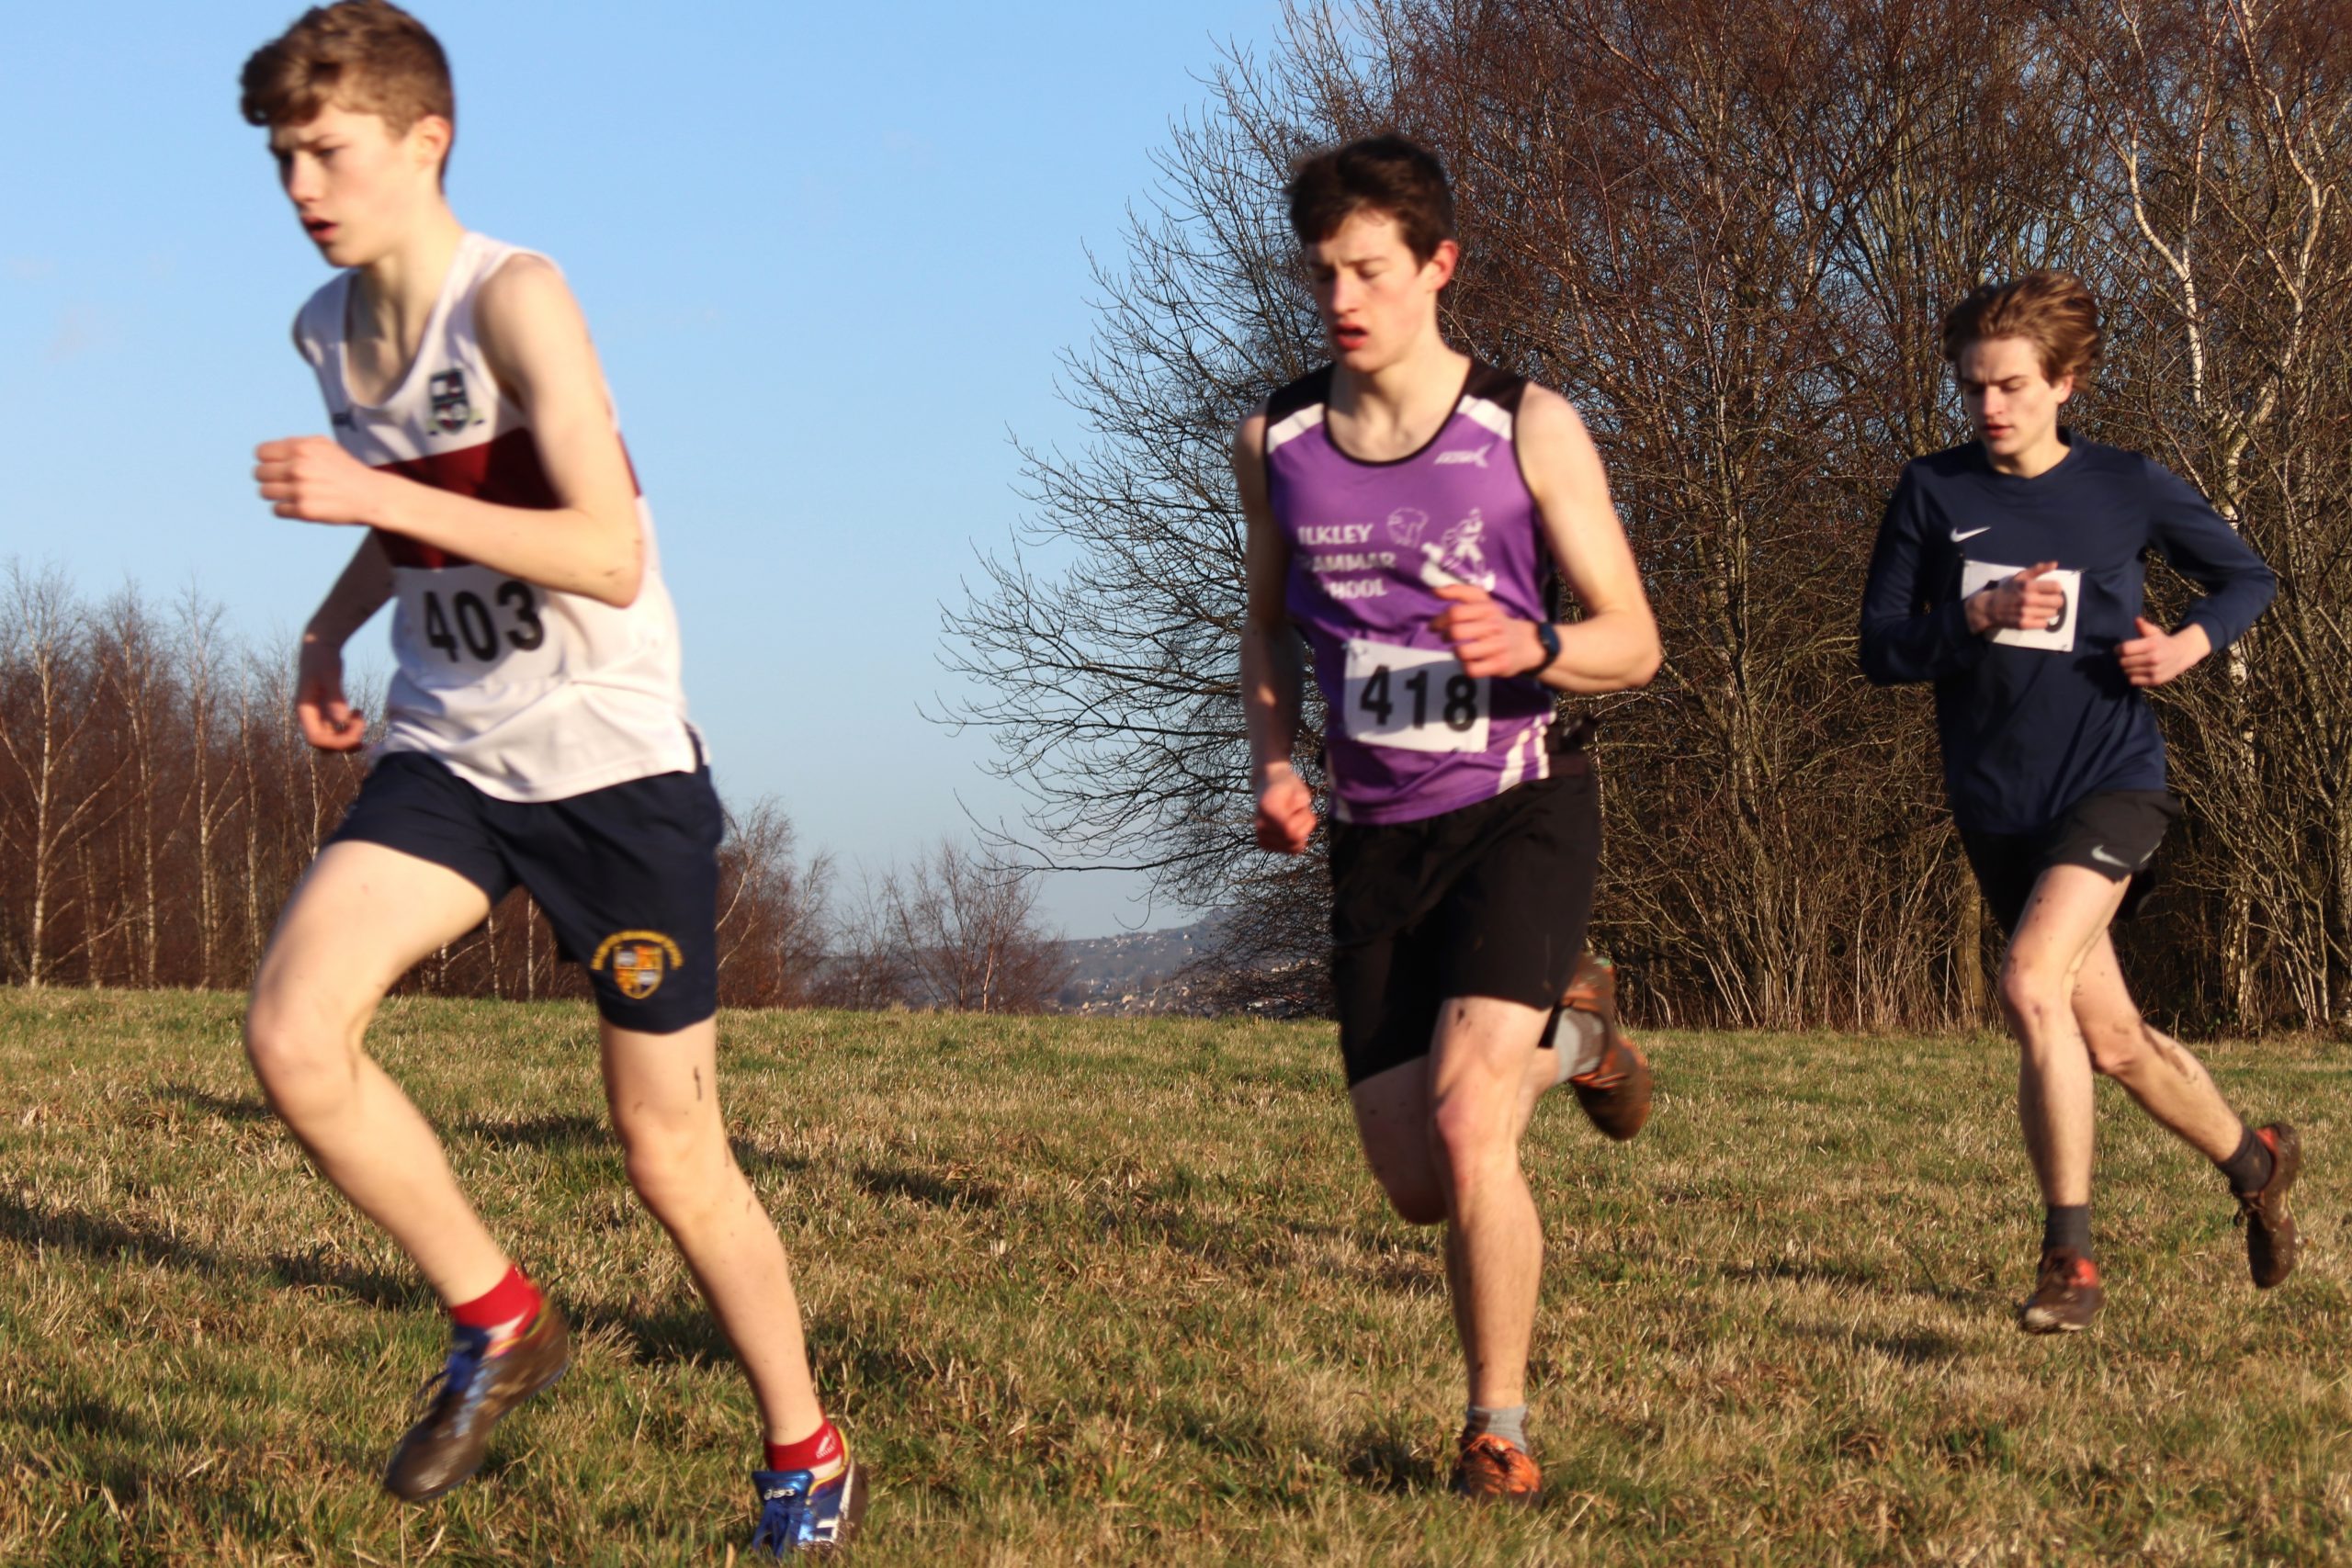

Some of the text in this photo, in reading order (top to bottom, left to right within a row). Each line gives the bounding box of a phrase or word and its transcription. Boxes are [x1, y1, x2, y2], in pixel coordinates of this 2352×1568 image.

[1297, 523, 1374, 546] ILKLEY
[1297, 551, 1396, 572] AMMAR
[1325, 577, 1388, 600] HOOL
[423, 580, 545, 662] 403
[1360, 664, 1477, 733] 418
